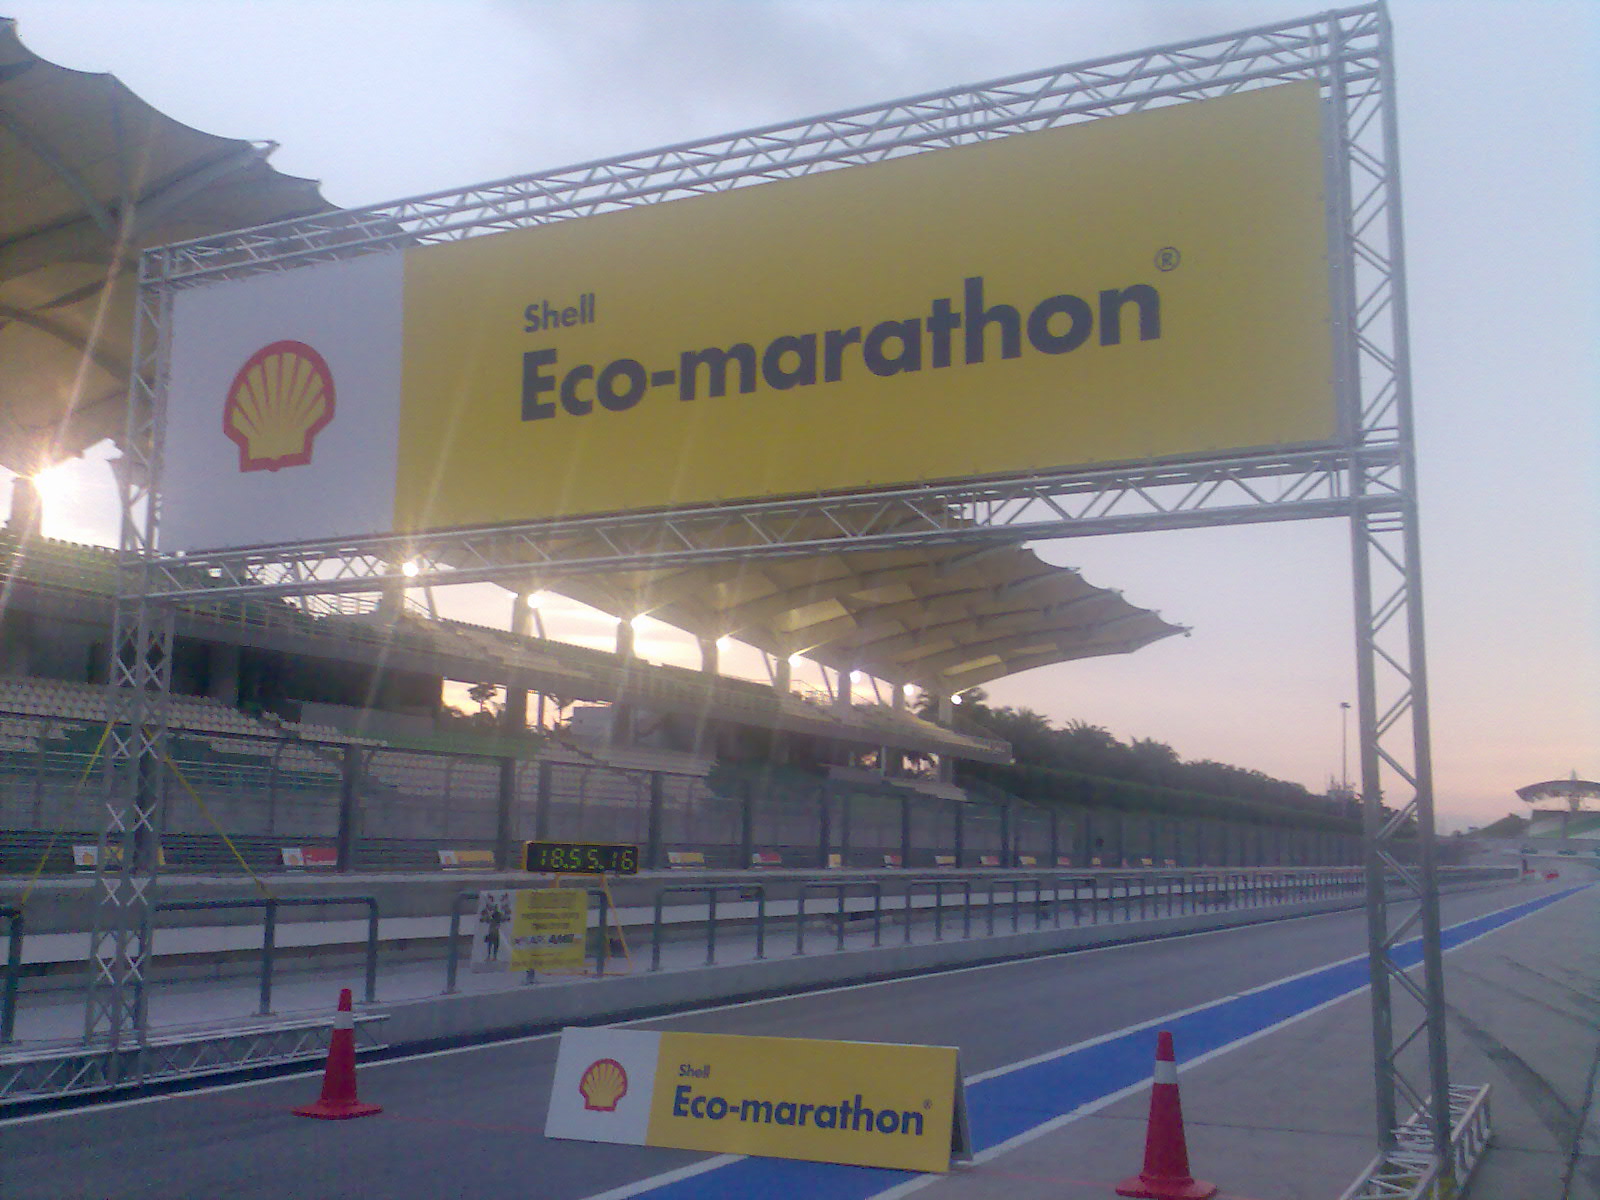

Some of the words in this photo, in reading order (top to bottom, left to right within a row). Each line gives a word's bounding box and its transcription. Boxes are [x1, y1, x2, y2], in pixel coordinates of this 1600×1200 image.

[523, 293, 595, 333] Shell
[521, 277, 1161, 421] Eco-marathon
[679, 1064, 710, 1079] Shell
[673, 1085, 924, 1135] Eco-marathon
